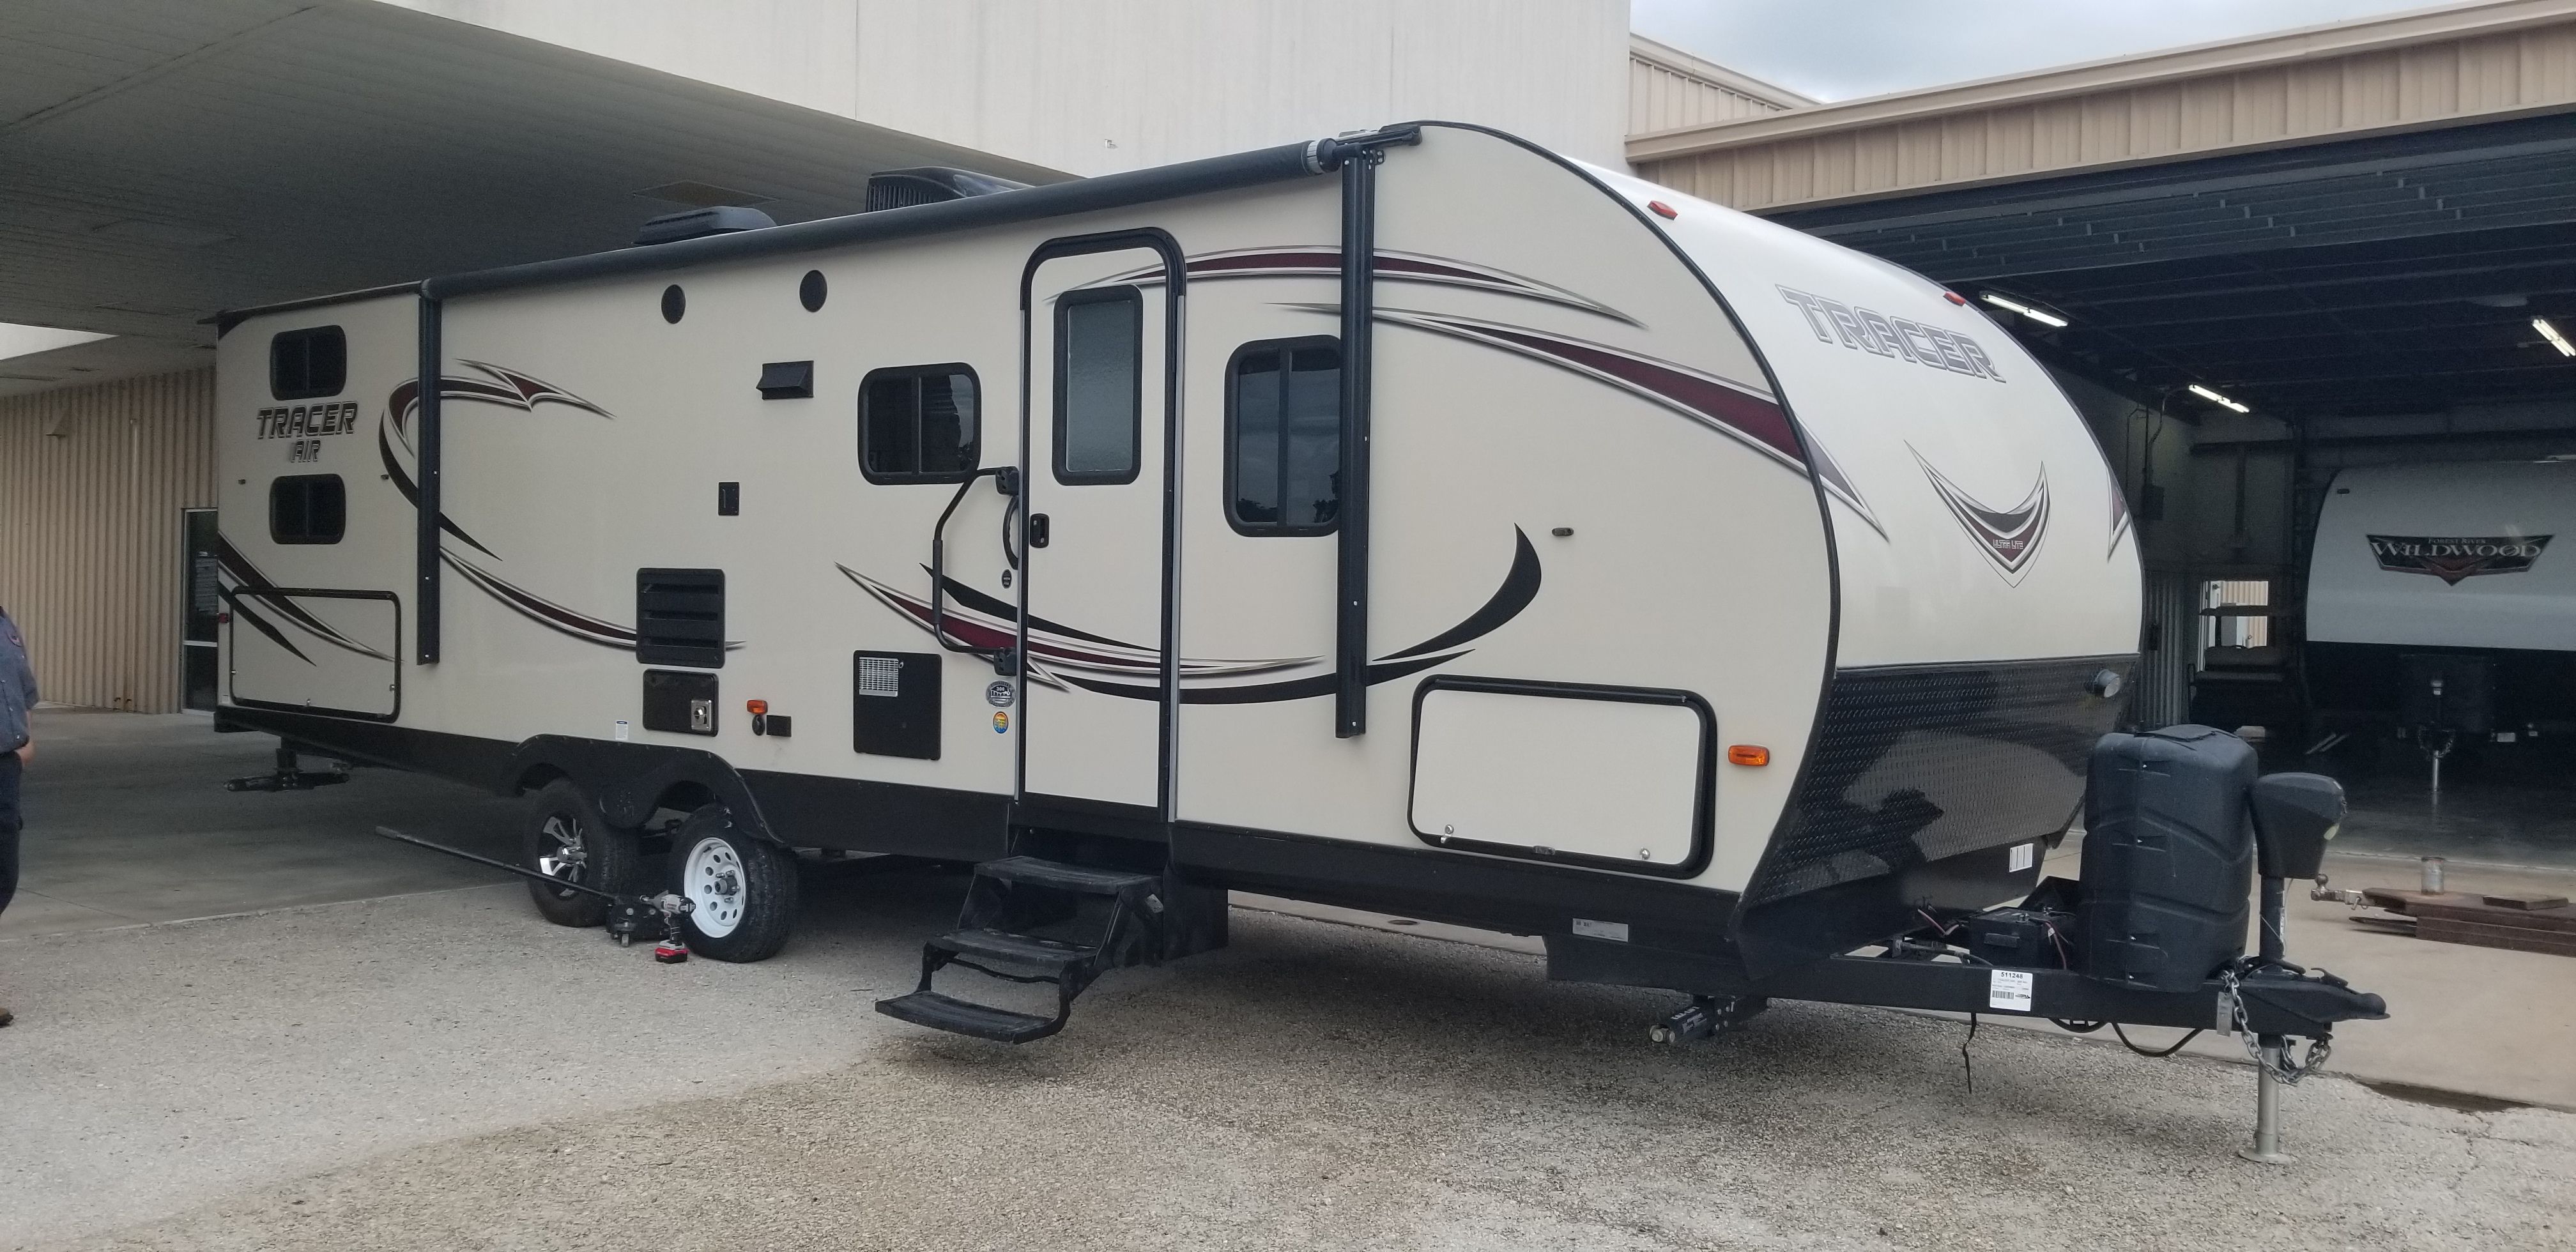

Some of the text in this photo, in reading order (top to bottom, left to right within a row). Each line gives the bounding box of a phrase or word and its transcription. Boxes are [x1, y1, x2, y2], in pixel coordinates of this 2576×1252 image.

[1775, 284, 2006, 383] TRACER
[257, 401, 358, 439] TRACER
[291, 439, 321, 463] AIR
[2371, 542, 2541, 556] WILDWOOD
